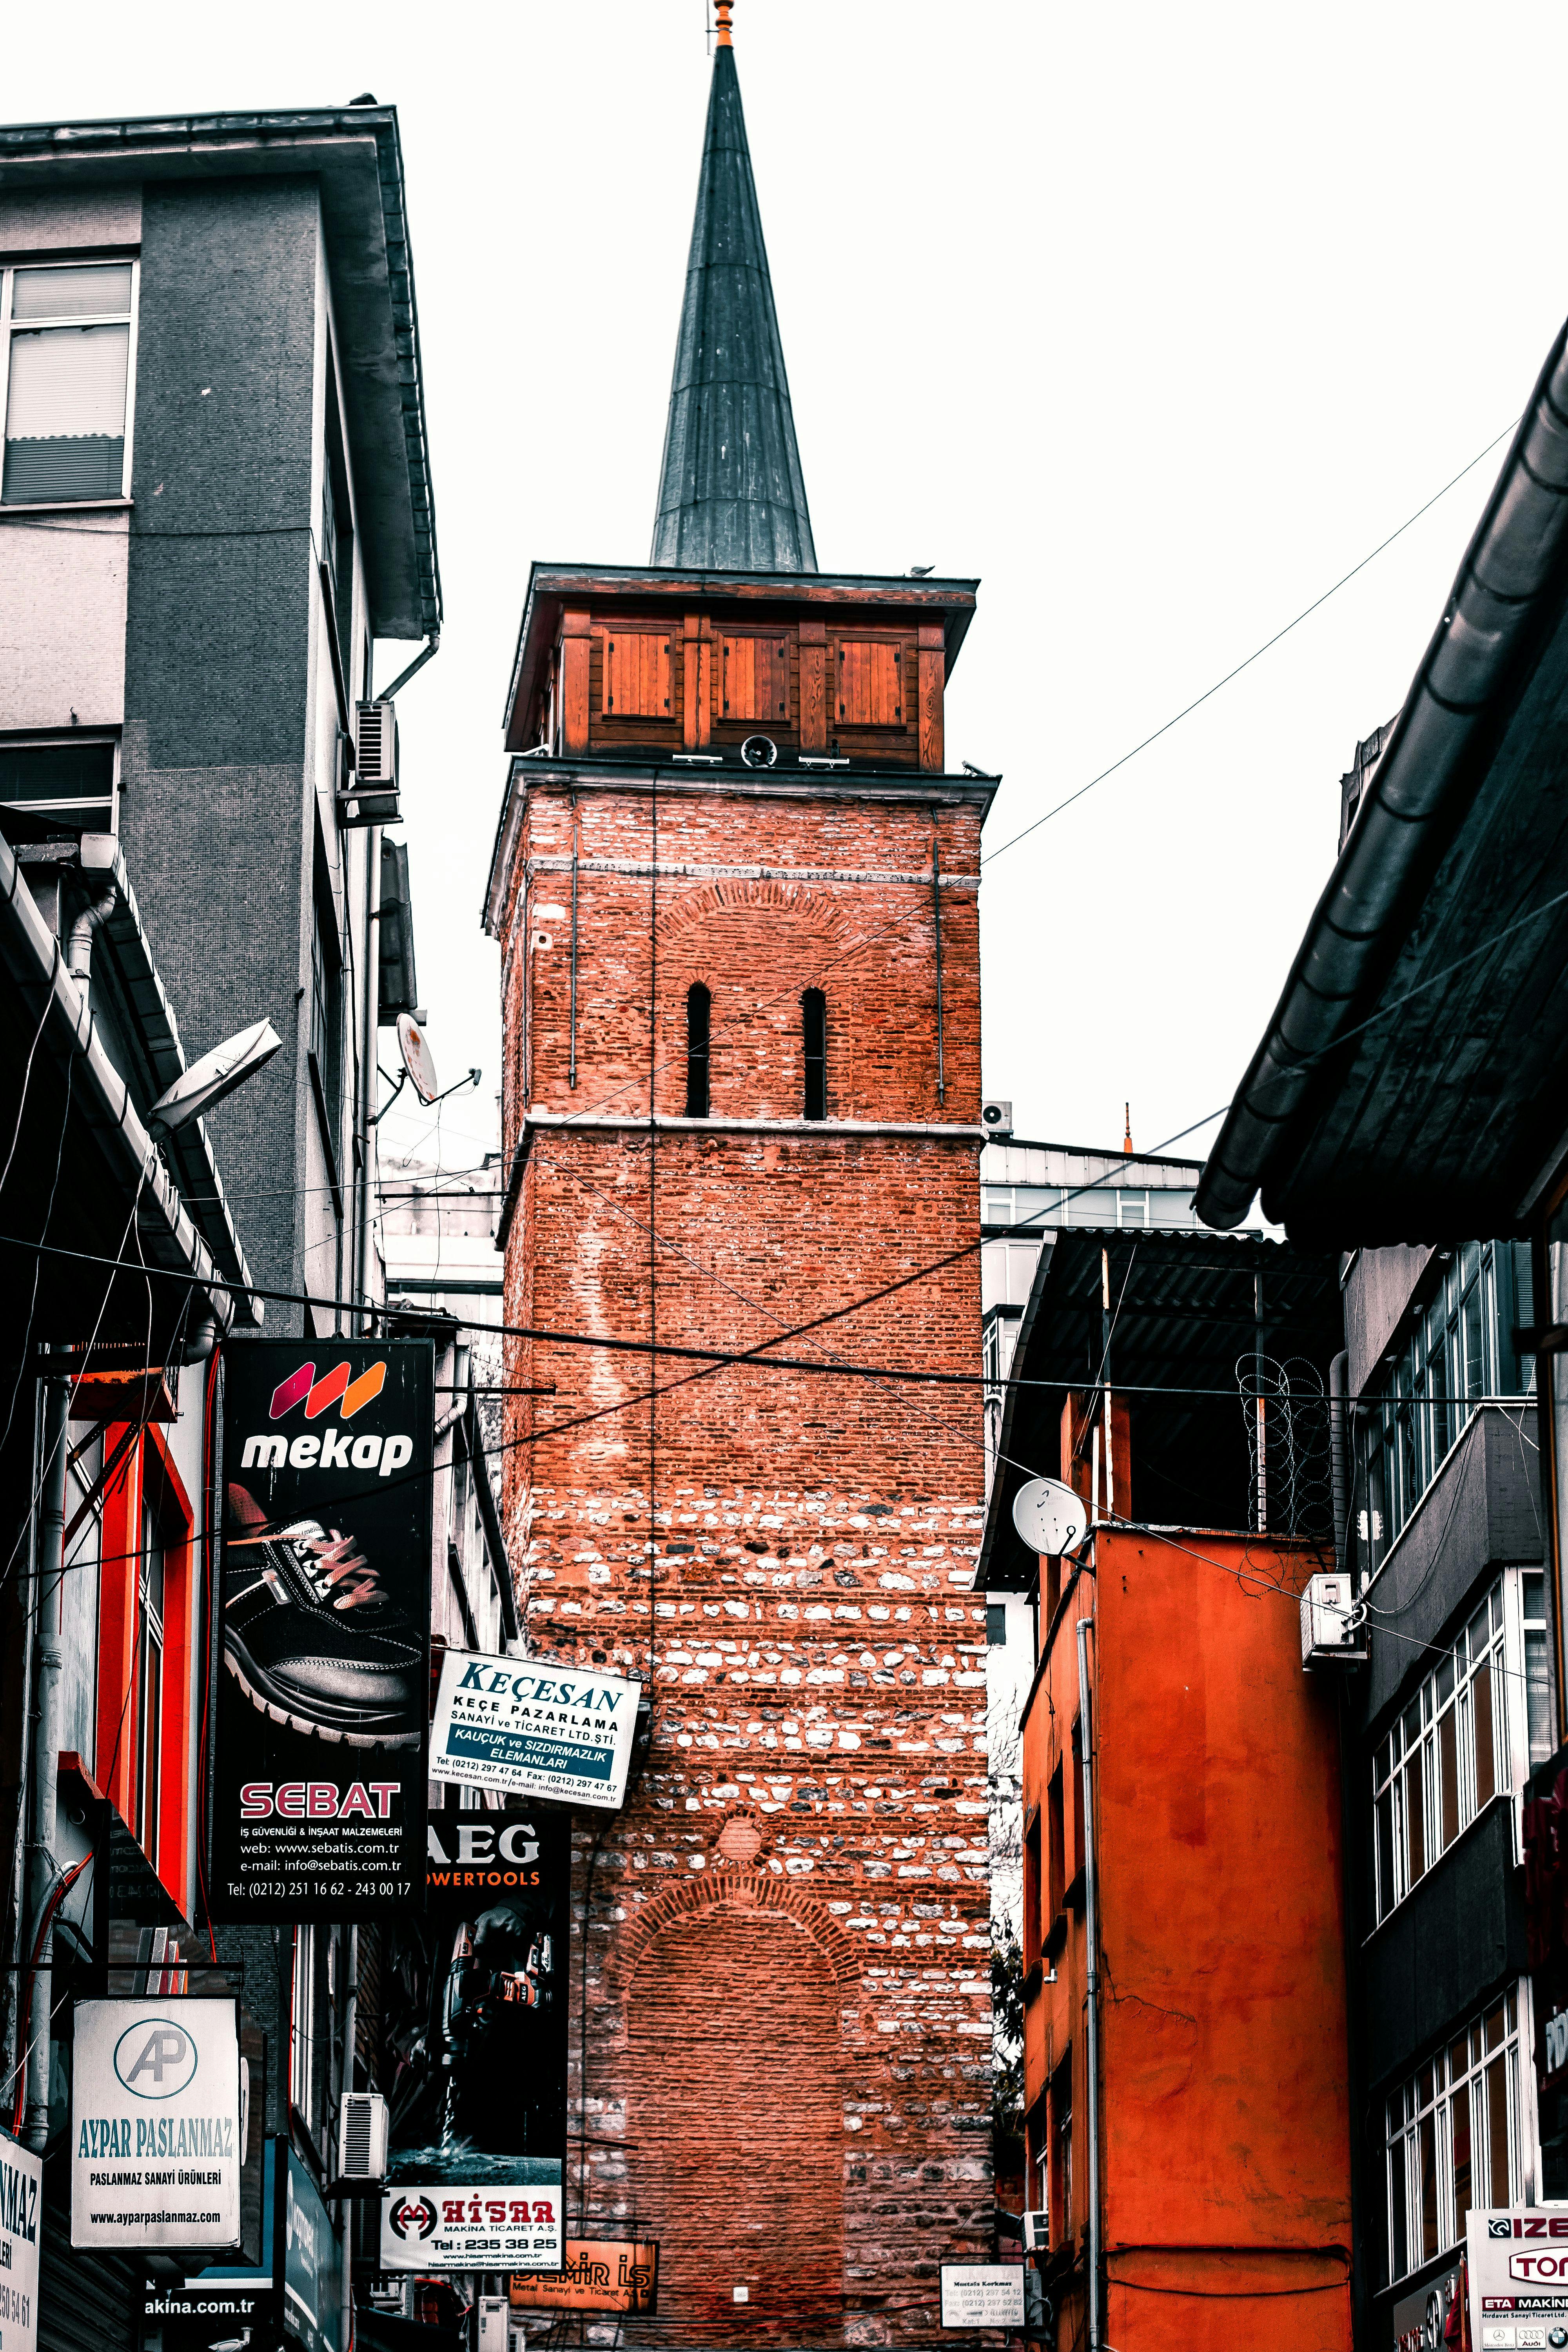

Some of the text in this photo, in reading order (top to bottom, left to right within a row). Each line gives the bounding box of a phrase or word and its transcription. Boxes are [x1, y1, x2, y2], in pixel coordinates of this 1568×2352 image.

[241, 1429, 413, 1476] mekap
[456, 1662, 624, 1712] KEÇESAN
[453, 1695, 618, 1731] KEÇE PAZARLAMA
[451, 1710, 495, 1725] SANAYİ
[514, 1720, 565, 1737] TİCARET
[455, 1729, 607, 1762] KAUÇUK ve SIZDIRMAZLIK
[490, 1748, 568, 1769] ELEMANLARI
[436, 1757, 450, 1765] Tel:
[452, 1759, 479, 1771] (0212)
[481, 1764, 497, 1773] 297
[512, 1769, 522, 1777] 64
[527, 1771, 545, 1781] Fax:
[548, 1775, 574, 1787] (0212)
[576, 1779, 592, 1788] 297
[240, 1782, 401, 1818] SEBAT
[538, 1784, 616, 1802] info@kecesan.com.tr
[241, 1826, 249, 1838] İŞ
[252, 1826, 296, 1836] GÜVENLİĞİ
[309, 1826, 339, 1838] İNŞAAT
[342, 1826, 402, 1836] MALZEMELERİ
[240, 1842, 399, 1853] web: www.sebatis.com.tr
[428, 1824, 539, 1864] AEG
[241, 1860, 401, 1871] e-mail: info@sebatis.com.tr
[427, 1872, 539, 1886] WERTOOLS
[227, 1883, 245, 1895] Tel:
[249, 1882, 285, 1898] (0212)
[289, 1882, 307, 1895] 251
[314, 1882, 327, 1895] 16
[330, 1882, 344, 1895] 62
[355, 1882, 376, 1895] 243
[379, 1882, 393, 1895] 00
[397, 1883, 410, 1895] 17
[78, 2117, 232, 2159] AYPAR PASLANMAZ
[90, 2169, 221, 2186] PASLANMAZ SANAYİ ÜRÜNLERİ
[442, 2193, 555, 2223] HİSAR
[90, 2210, 220, 2226] www.ayparpaslanmaz.com
[430, 2240, 453, 2250] Tel
[465, 2239, 501, 2250] 235
[505, 2239, 529, 2249] 38
[533, 2239, 557, 2249] 25
[513, 2282, 538, 2292] Metal
[589, 2287, 619, 2297] Ticaret
[0, 2283, 9, 2320] 50
[145, 2299, 255, 2314] akina.com.tr
[1485, 2299, 1512, 2308] ETA
